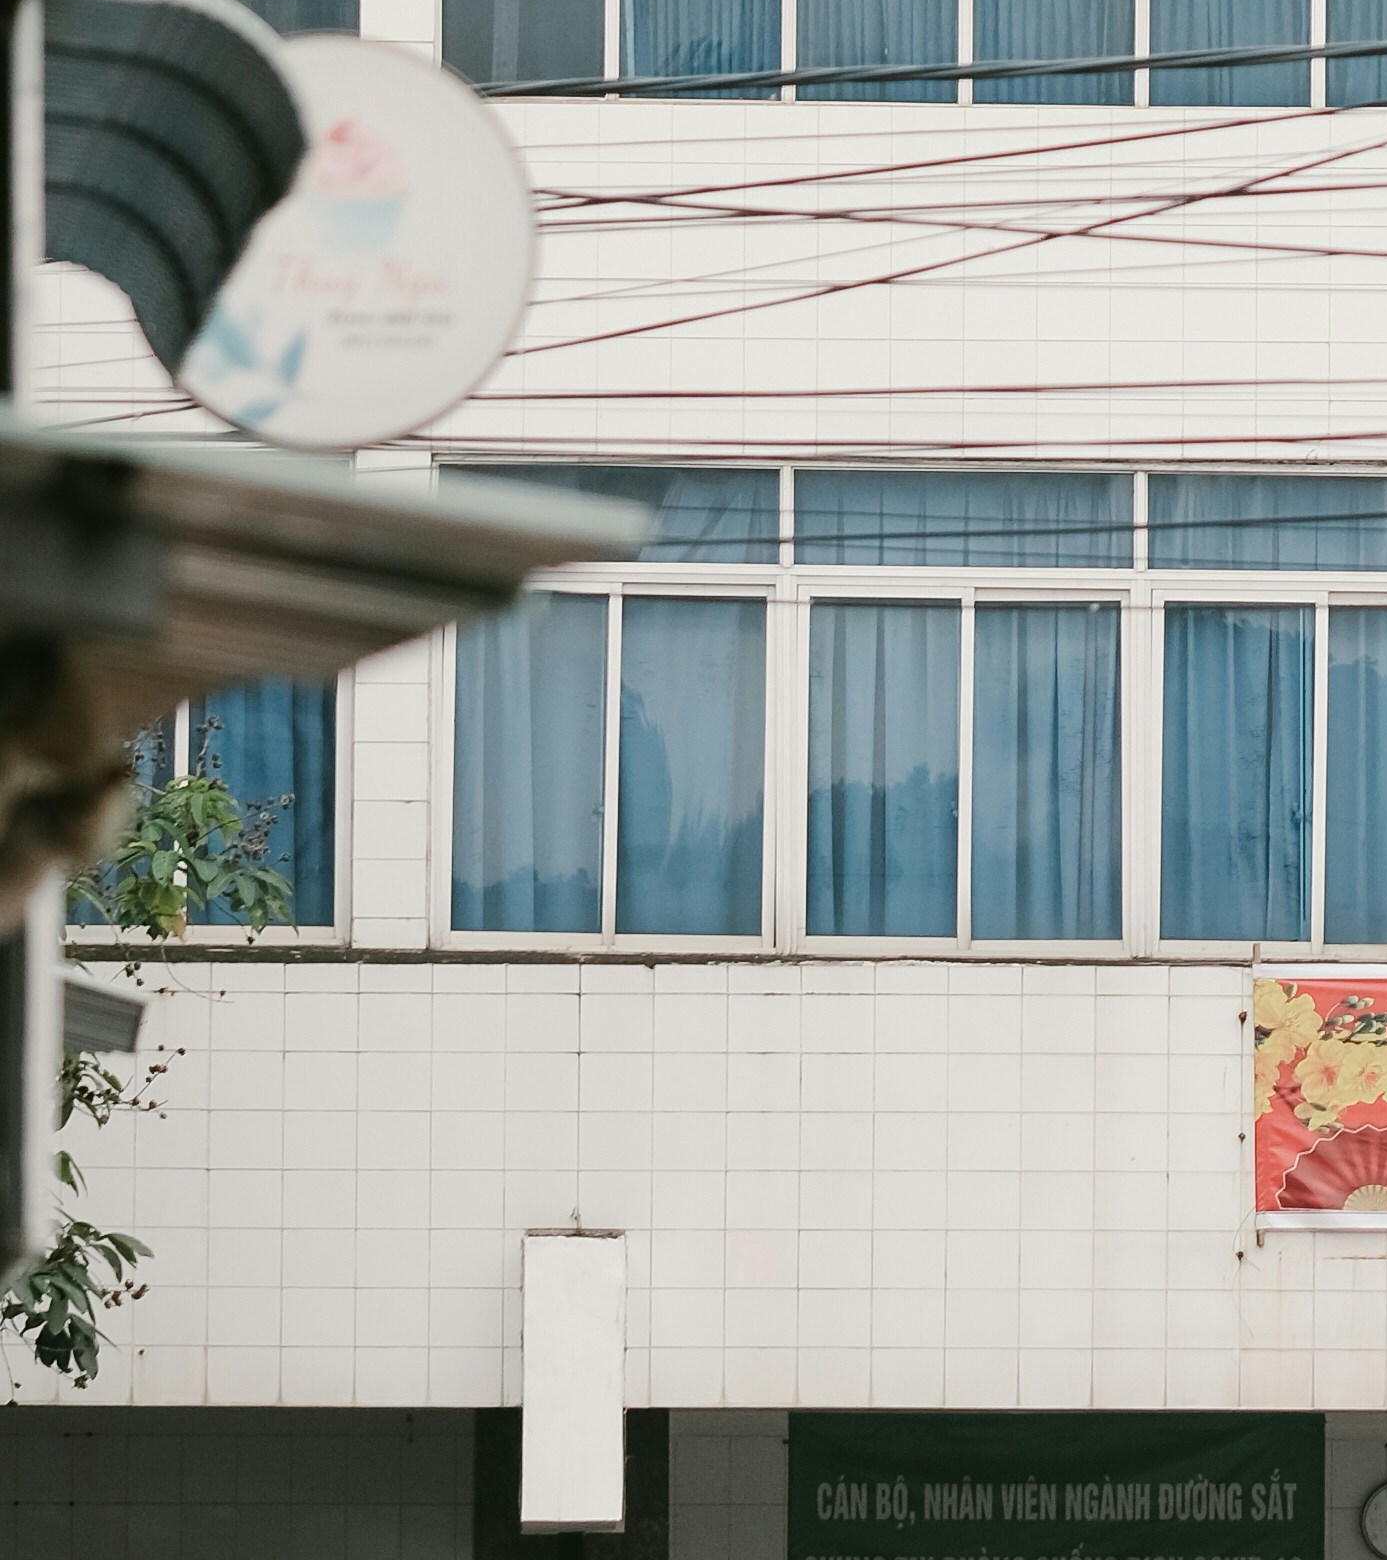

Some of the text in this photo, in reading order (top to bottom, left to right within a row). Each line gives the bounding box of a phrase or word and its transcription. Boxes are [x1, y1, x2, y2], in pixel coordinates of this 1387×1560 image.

[816, 1474, 869, 1521] CÁN
[923, 1474, 994, 1521] NHÂN
[1000, 1474, 1058, 1521] VIÊN
[1064, 1476, 1151, 1521] NGÀNH
[1156, 1473, 1243, 1521] ĐƯỜNG
[1250, 1467, 1299, 1521] SẮT
